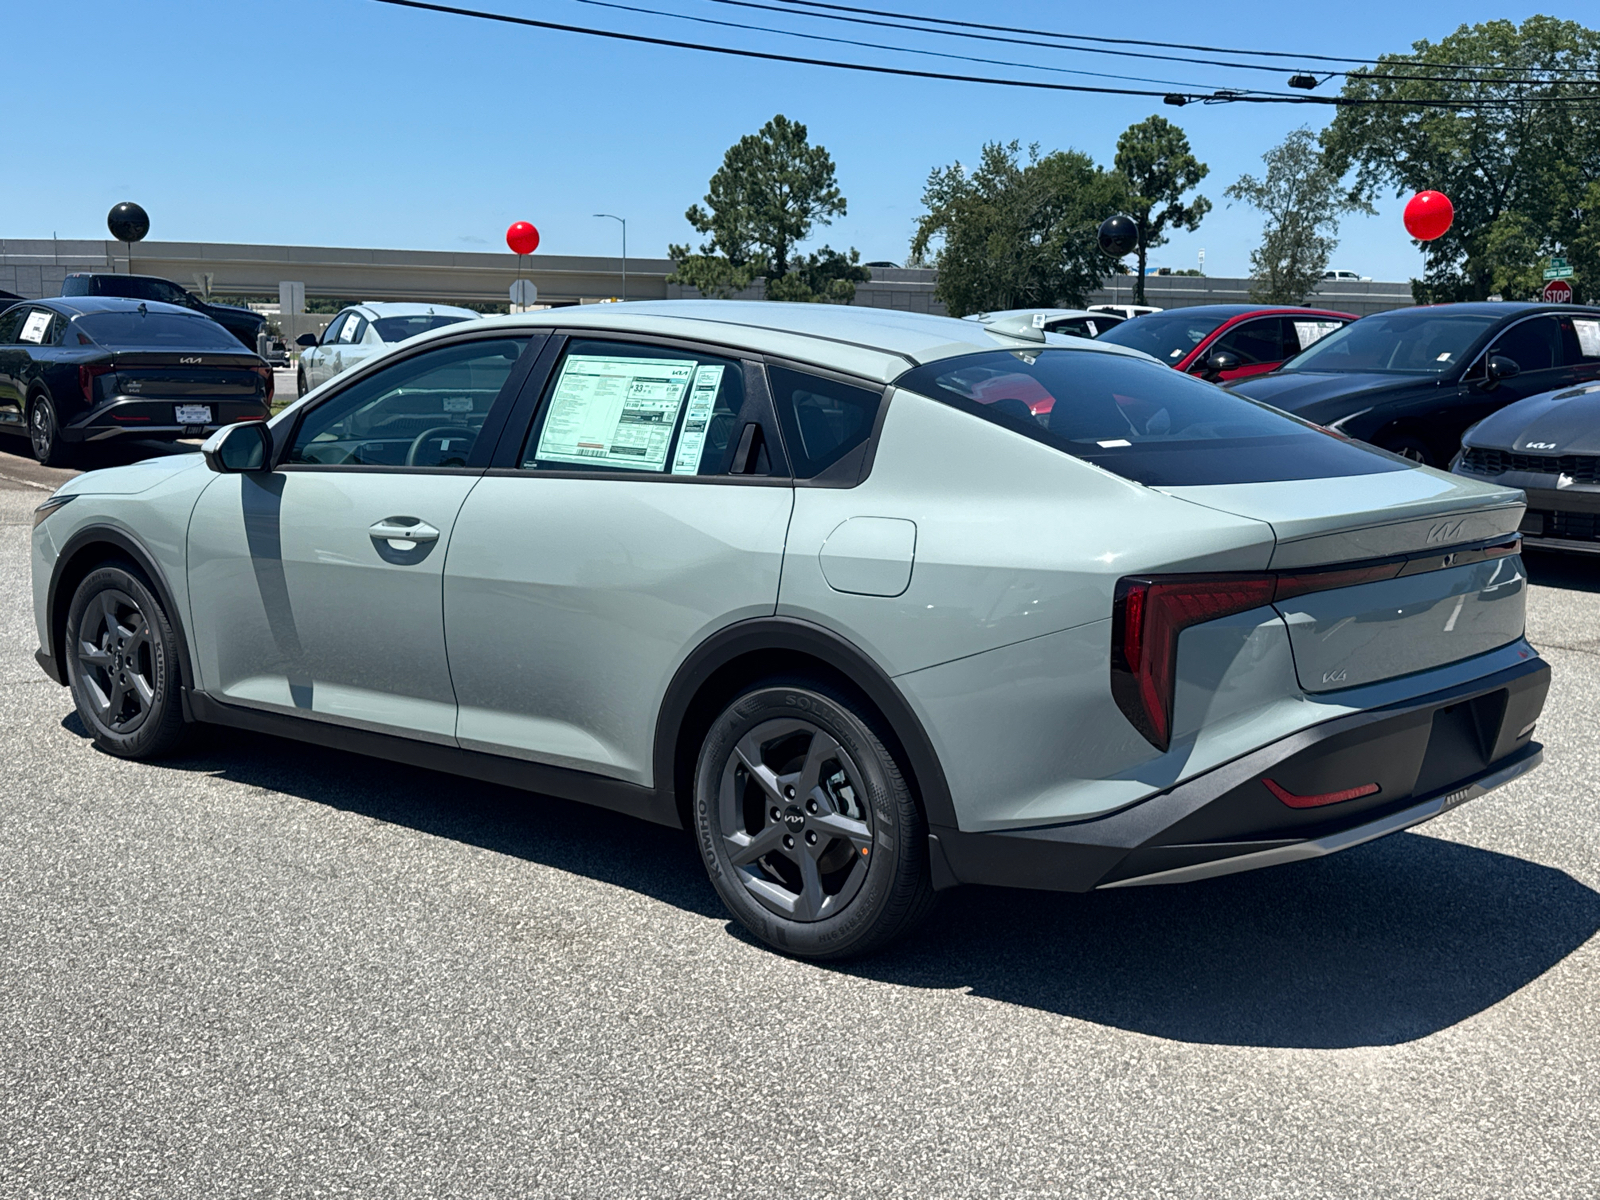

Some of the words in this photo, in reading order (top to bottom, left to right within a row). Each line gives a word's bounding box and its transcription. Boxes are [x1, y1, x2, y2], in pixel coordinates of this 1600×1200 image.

[1545, 290, 1570, 303] STOP
[1525, 442, 1557, 450] KIA
[1425, 518, 1467, 544] KIA
[155, 642, 164, 703] KUMHO
[1322, 669, 1347, 684] K4
[785, 694, 847, 731] SOLUS
[785, 815, 804, 823] KIA
[698, 799, 723, 880] KUMHO
